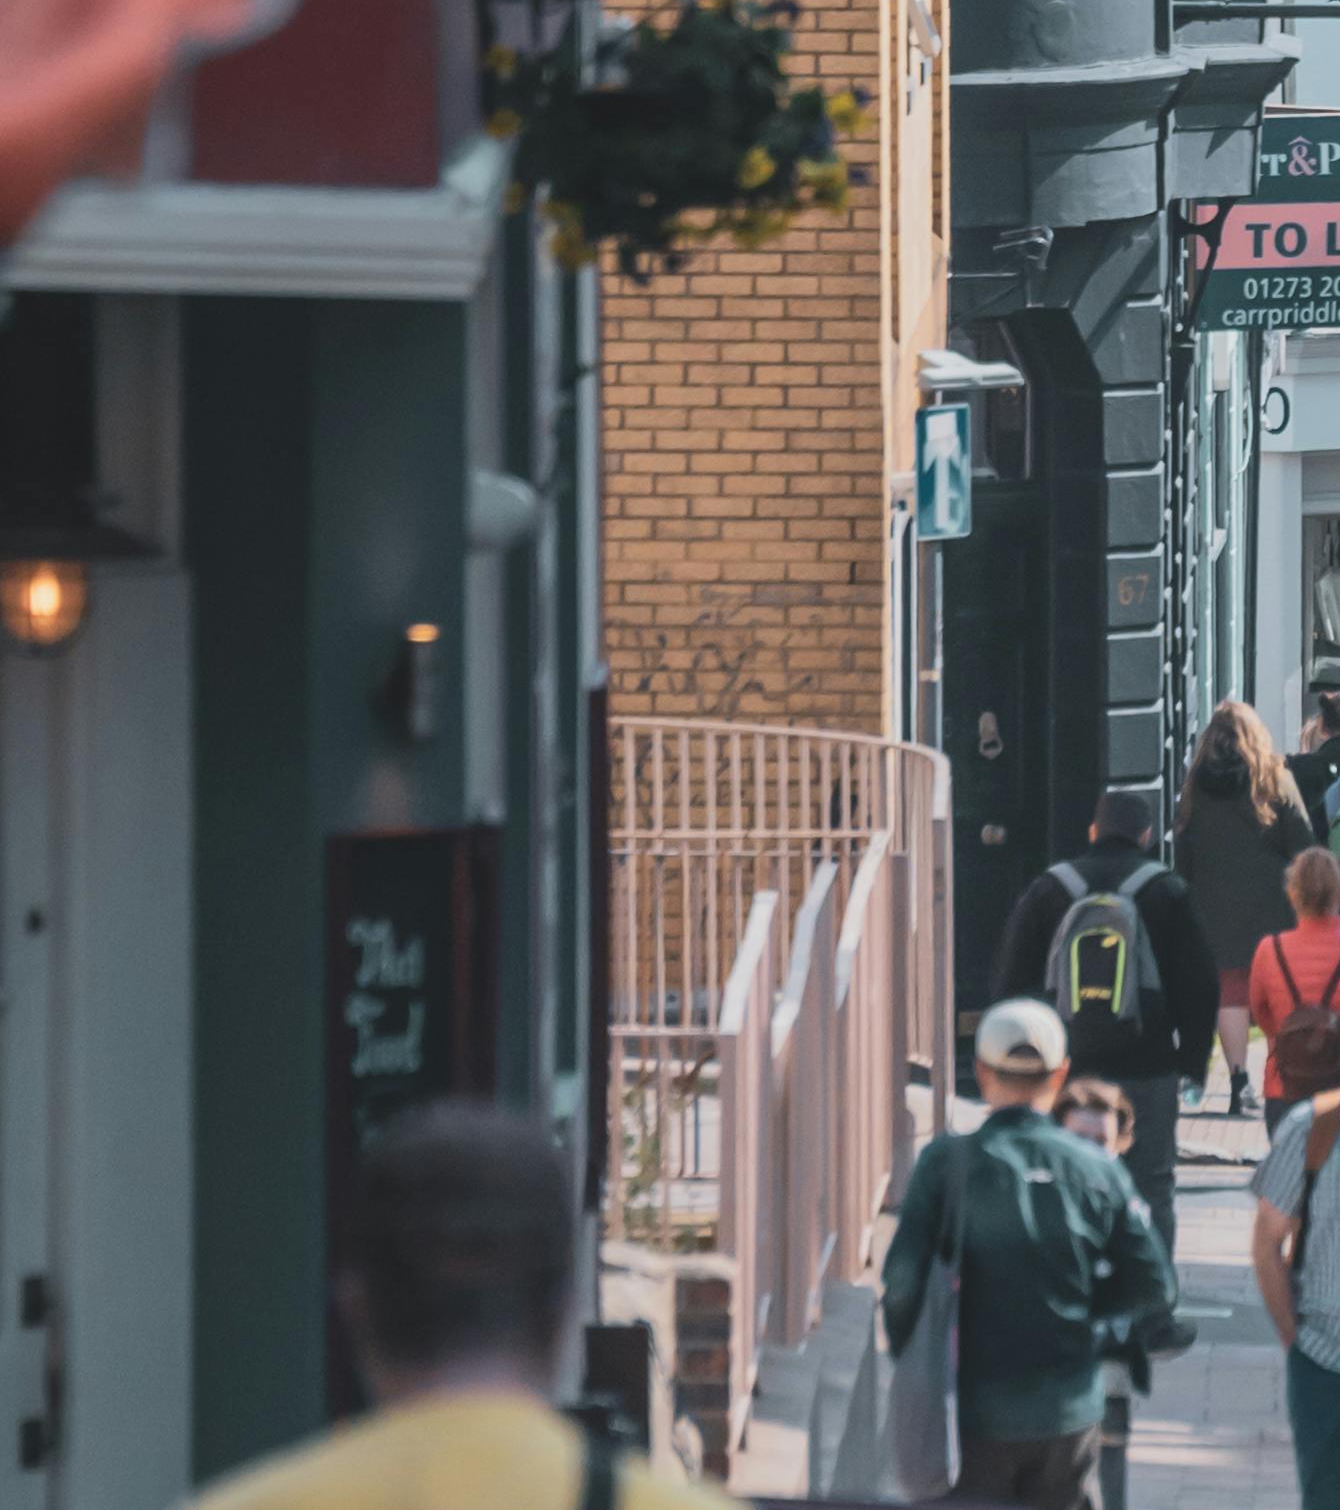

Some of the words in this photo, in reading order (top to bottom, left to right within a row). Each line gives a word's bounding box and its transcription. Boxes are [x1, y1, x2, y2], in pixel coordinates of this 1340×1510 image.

[1245, 222, 1308, 258] TO
[1244, 277, 1312, 300] 01273
[1117, 574, 1150, 606] 67
